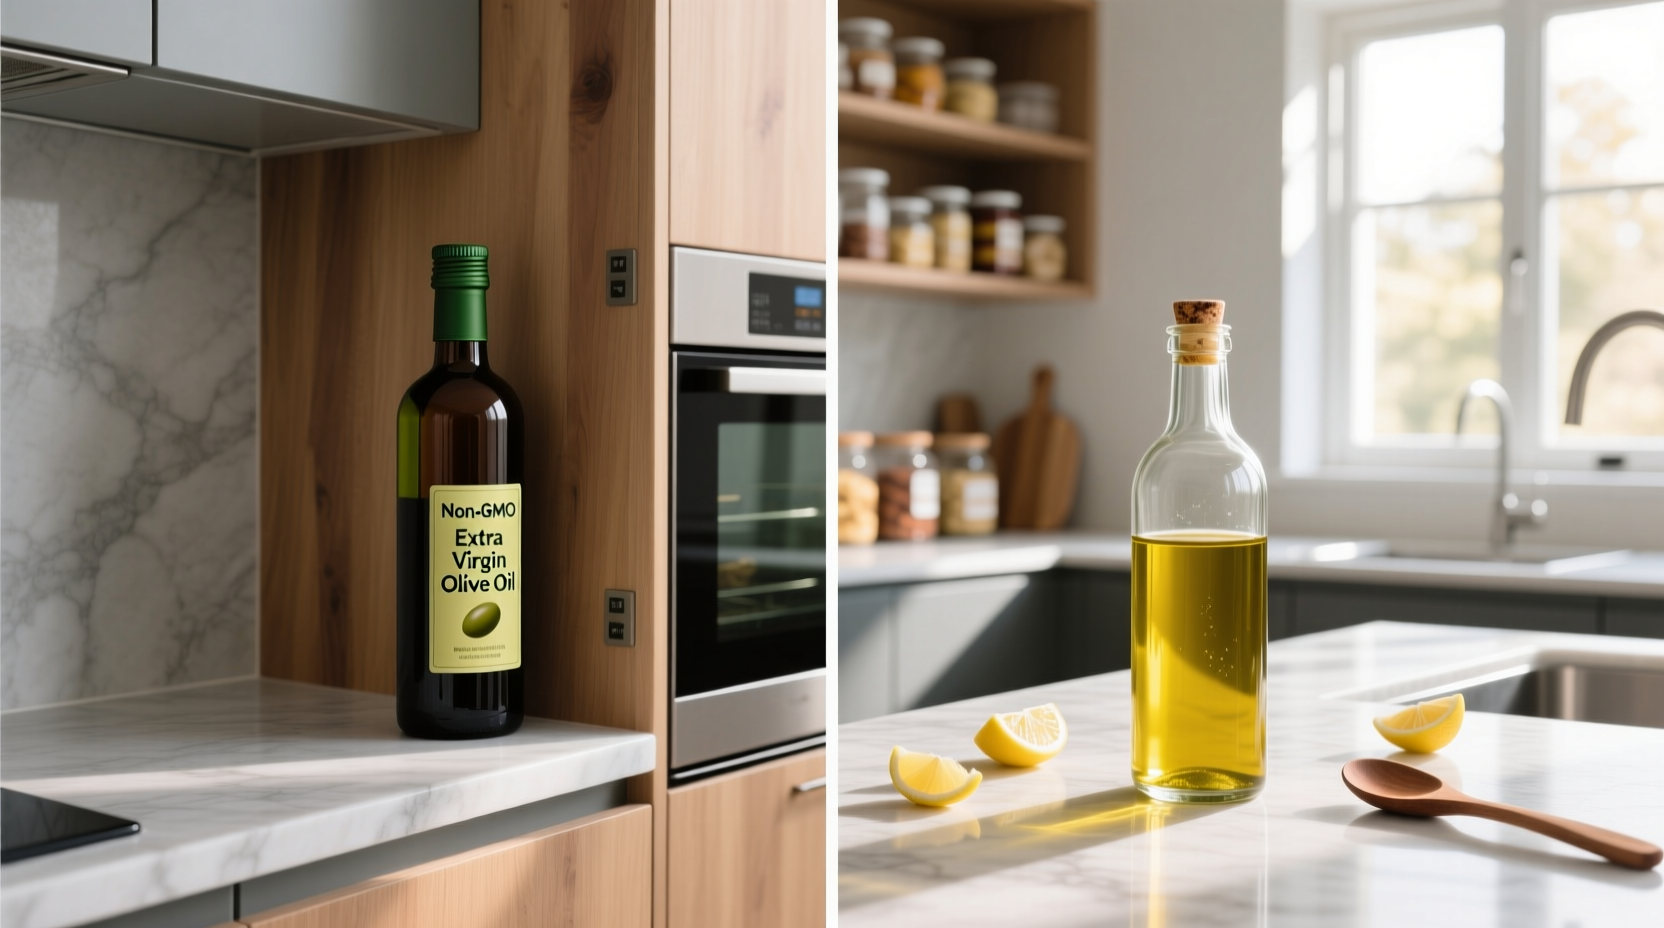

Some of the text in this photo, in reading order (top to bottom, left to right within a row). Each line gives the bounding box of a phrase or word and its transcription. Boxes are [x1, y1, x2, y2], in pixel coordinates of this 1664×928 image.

[441, 502, 516, 518] Non-GMO
[455, 528, 503, 547] Extra
[451, 550, 507, 573] Virgin
[441, 571, 515, 593] Olive Oil
